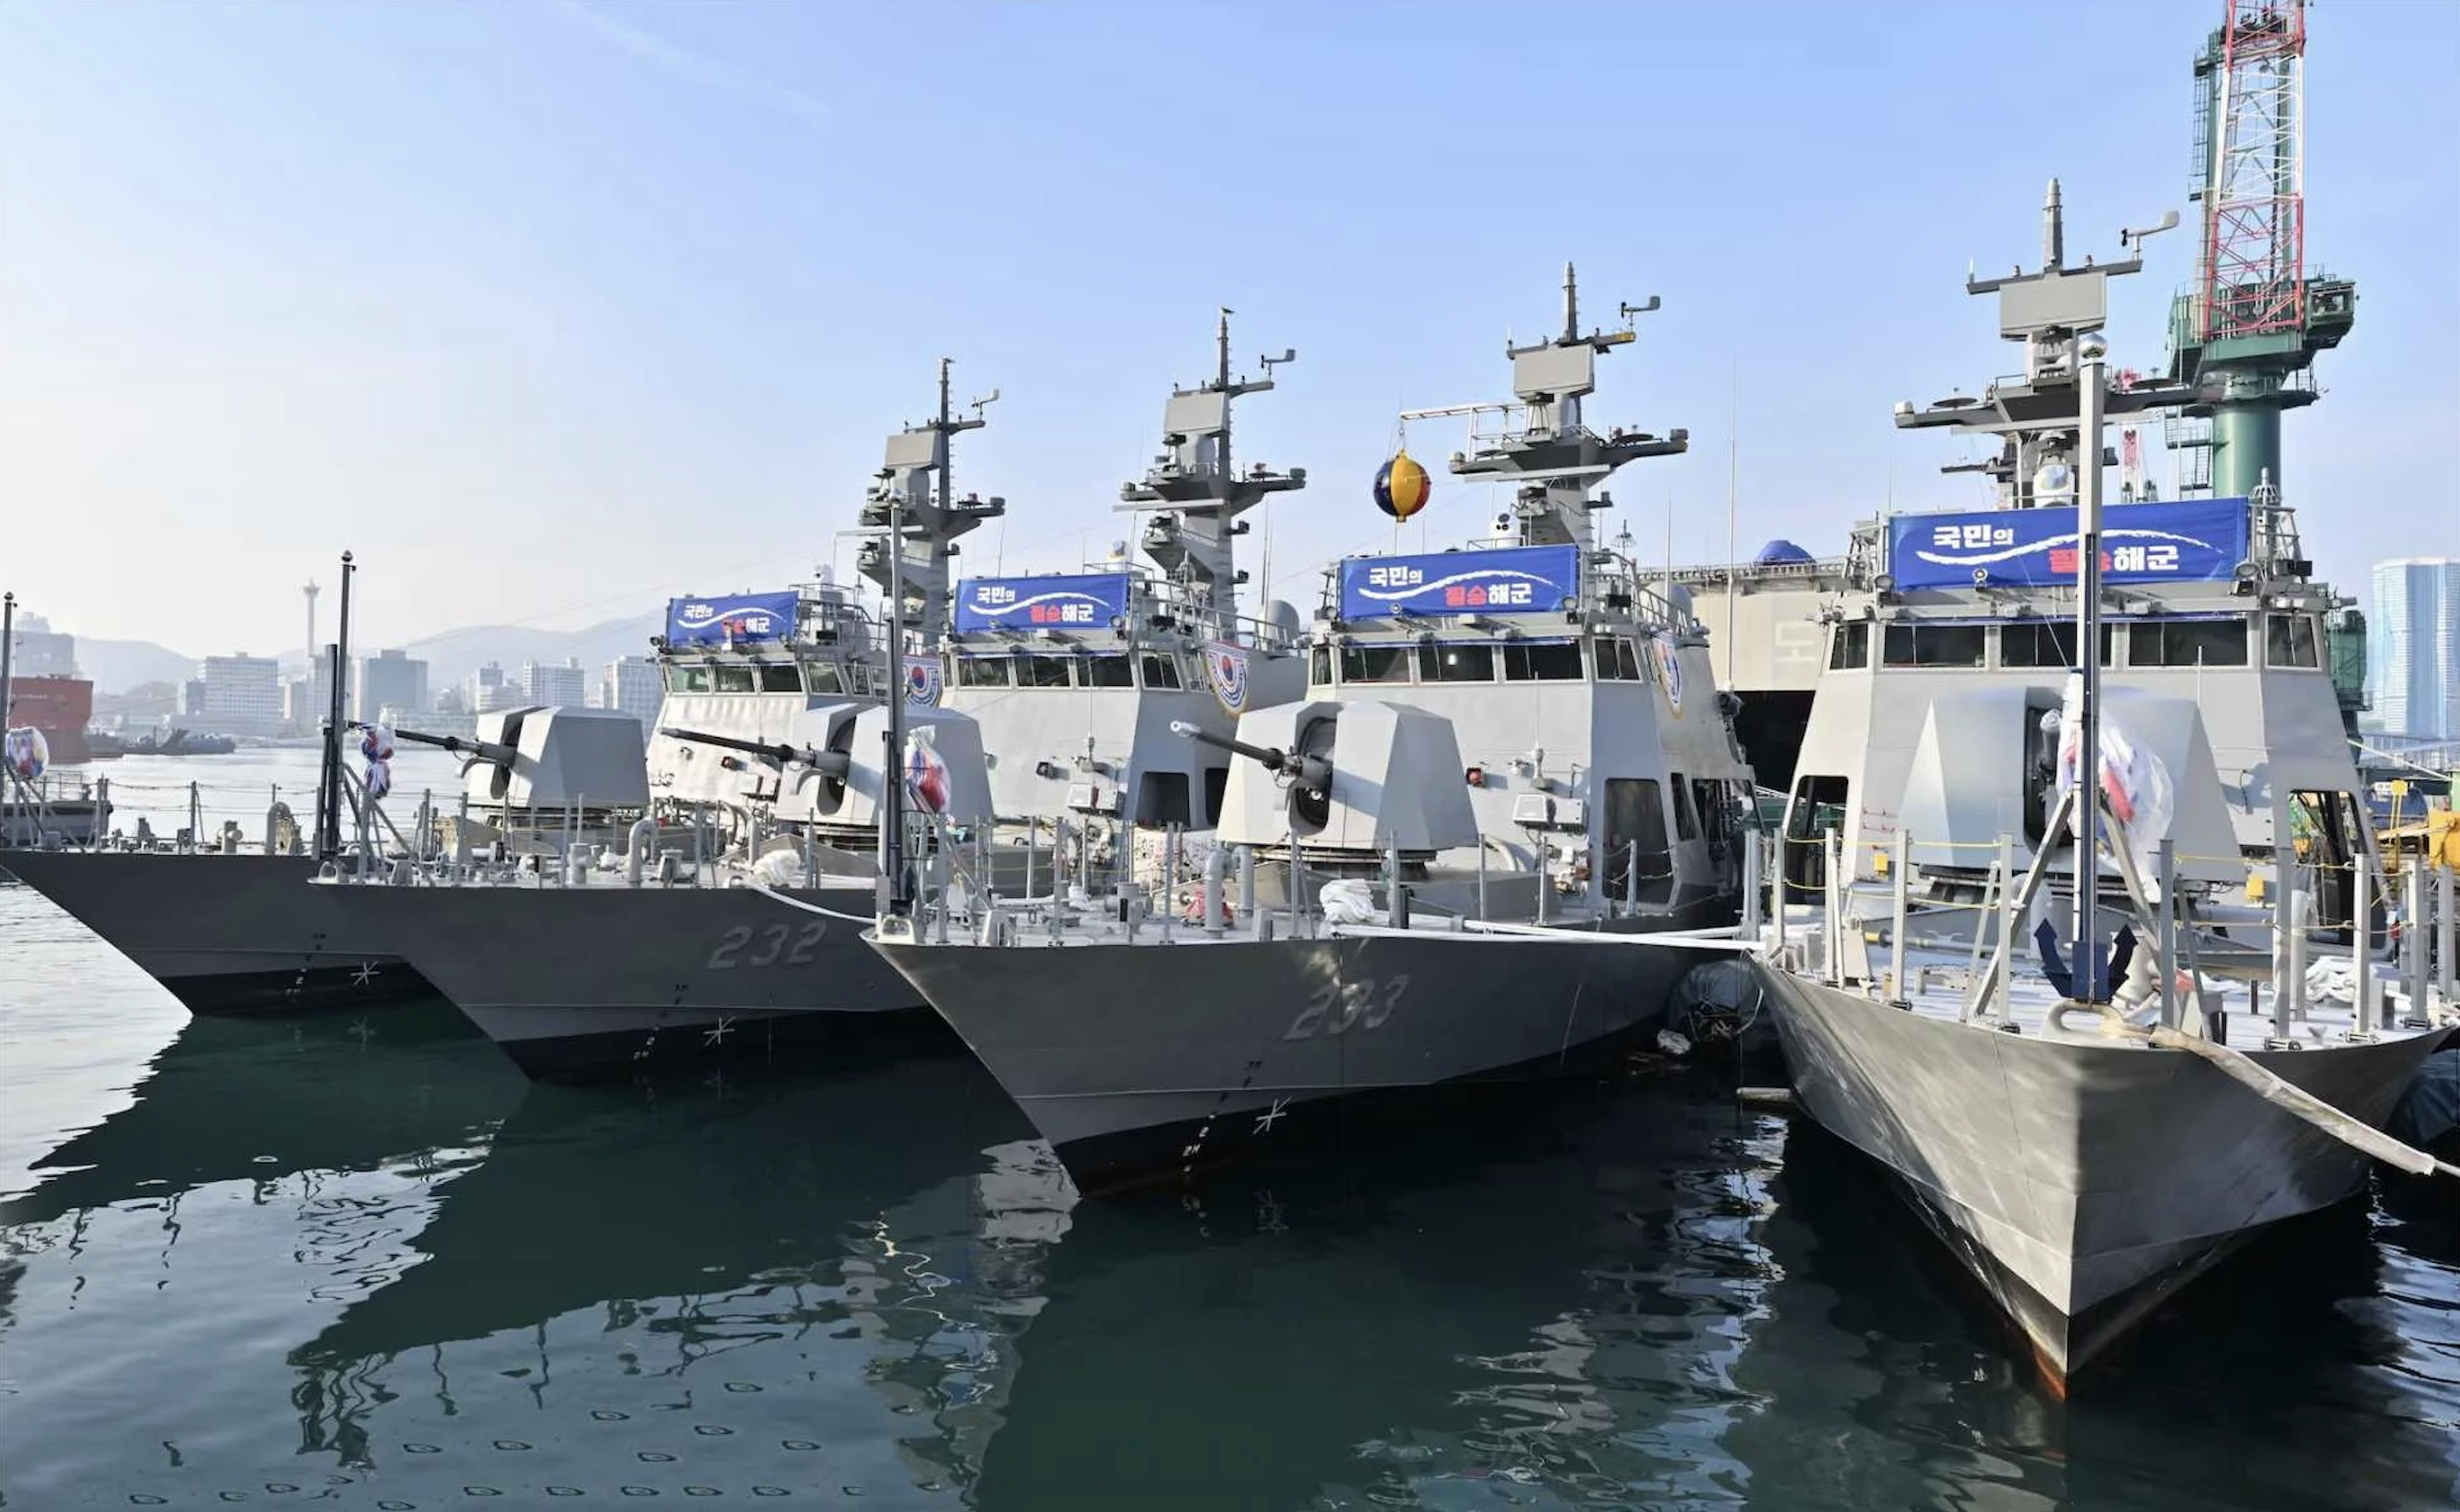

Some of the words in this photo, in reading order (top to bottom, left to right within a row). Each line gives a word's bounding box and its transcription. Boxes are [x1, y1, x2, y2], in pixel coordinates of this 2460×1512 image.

[1933, 524, 2015, 550] 국민의
[1369, 566, 1422, 587] 국민의
[977, 586, 1016, 604] 국민의
[706, 919, 827, 970] 232
[1282, 974, 1411, 1041] 233
